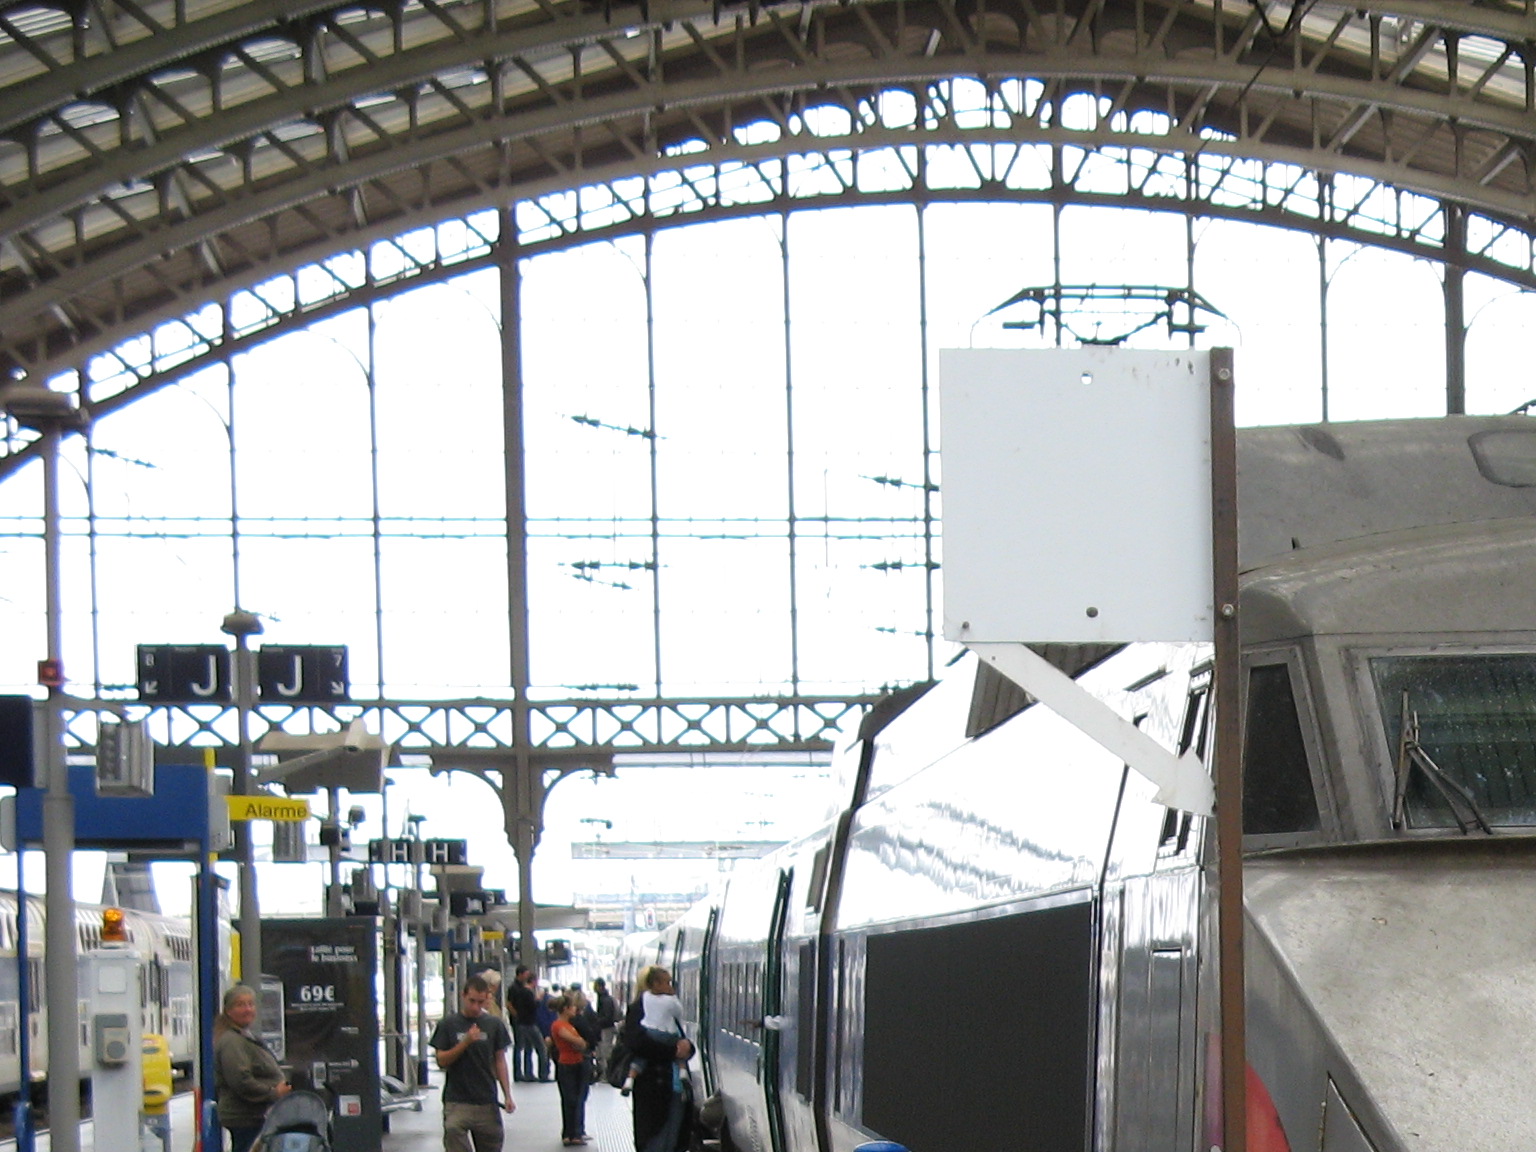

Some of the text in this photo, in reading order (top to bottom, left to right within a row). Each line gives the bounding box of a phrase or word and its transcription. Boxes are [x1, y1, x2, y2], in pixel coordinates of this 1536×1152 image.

[333, 655, 343, 667] 7
[190, 654, 218, 697] J
[276, 654, 303, 697] J
[244, 802, 308, 819] Alarme
[391, 842, 408, 862] H
[432, 842, 449, 862] H
[300, 984, 335, 1002] 69€
